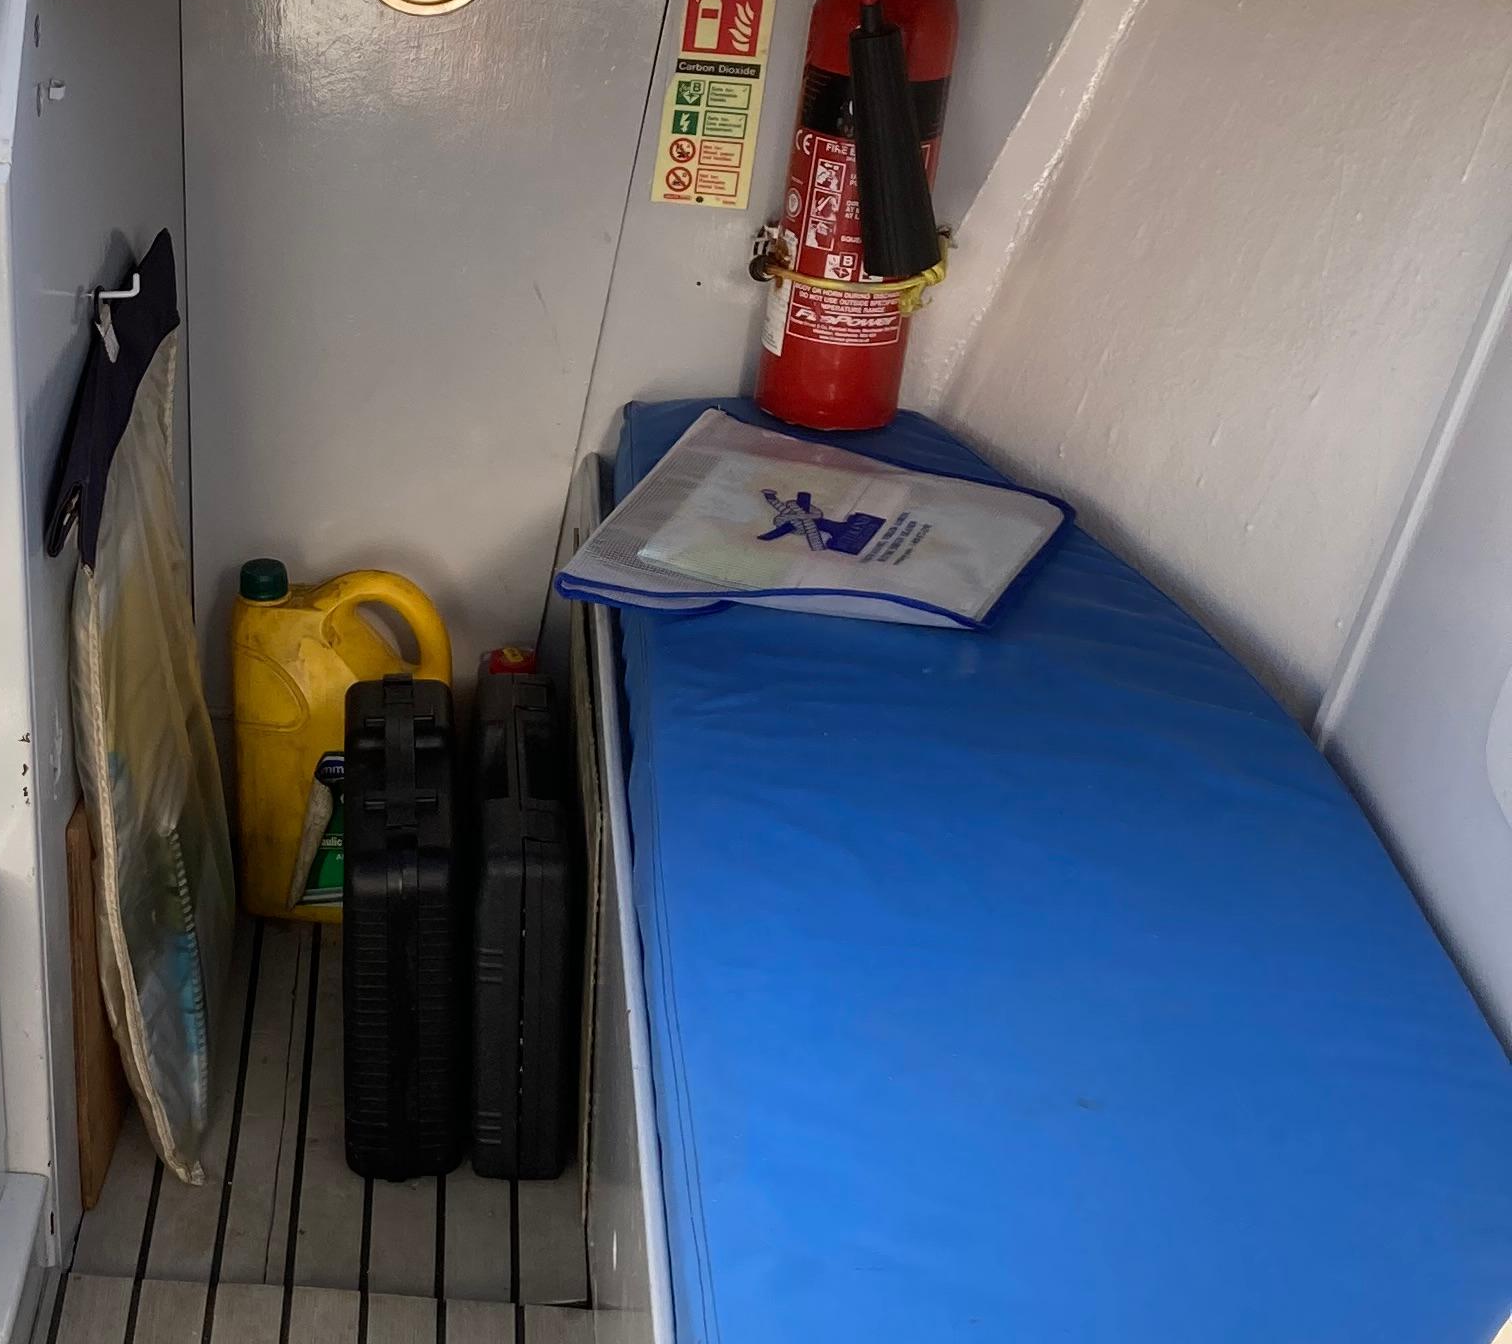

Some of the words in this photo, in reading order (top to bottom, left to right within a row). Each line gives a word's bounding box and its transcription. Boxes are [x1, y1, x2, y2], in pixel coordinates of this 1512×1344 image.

[678, 61, 716, 73] Carbon
[718, 64, 757, 76] Dioxide
[825, 143, 848, 156] FIRE
[321, 837, 343, 847] aulic
